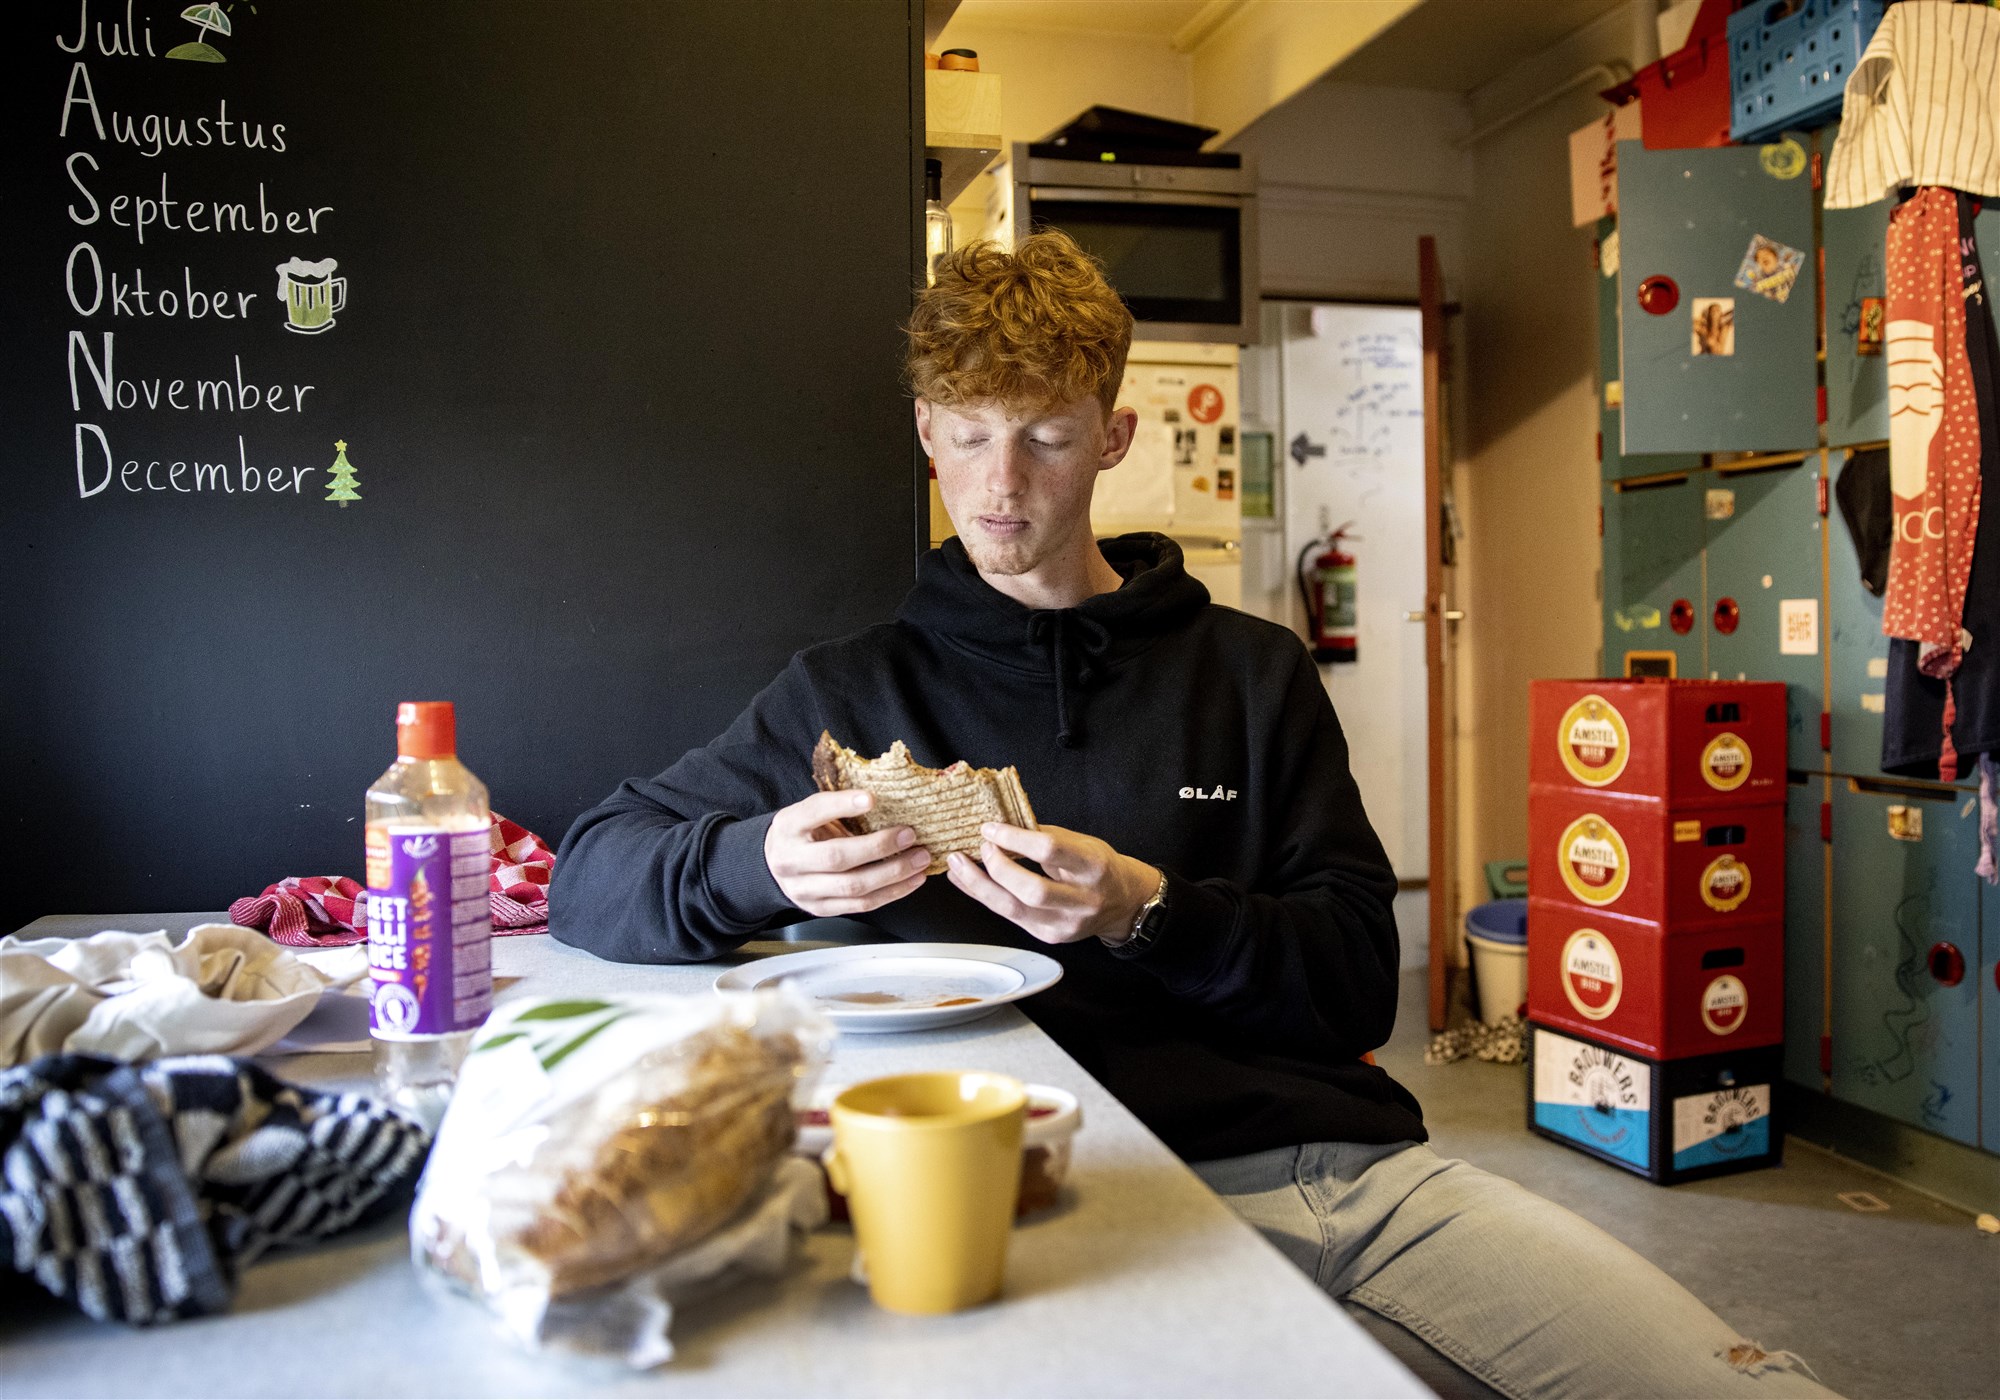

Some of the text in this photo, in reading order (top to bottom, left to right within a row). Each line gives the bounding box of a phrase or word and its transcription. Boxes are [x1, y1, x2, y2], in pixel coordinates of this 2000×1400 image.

[56, 0, 156, 57] Juli
[59, 62, 287, 157] Augustus
[65, 152, 334, 245] September
[66, 242, 257, 319] Oktober
[68, 330, 315, 412] November
[75, 423, 315, 499] December
[1574, 727, 1613, 743] AMSTEL
[1178, 784, 1238, 801] ØLÅF
[1574, 844, 1613, 863] AMSTEL
[1573, 957, 1611, 978] AMSTEL
[1568, 1046, 1638, 1105] BROUWERS
[1703, 1088, 1760, 1124] BROUWERS
